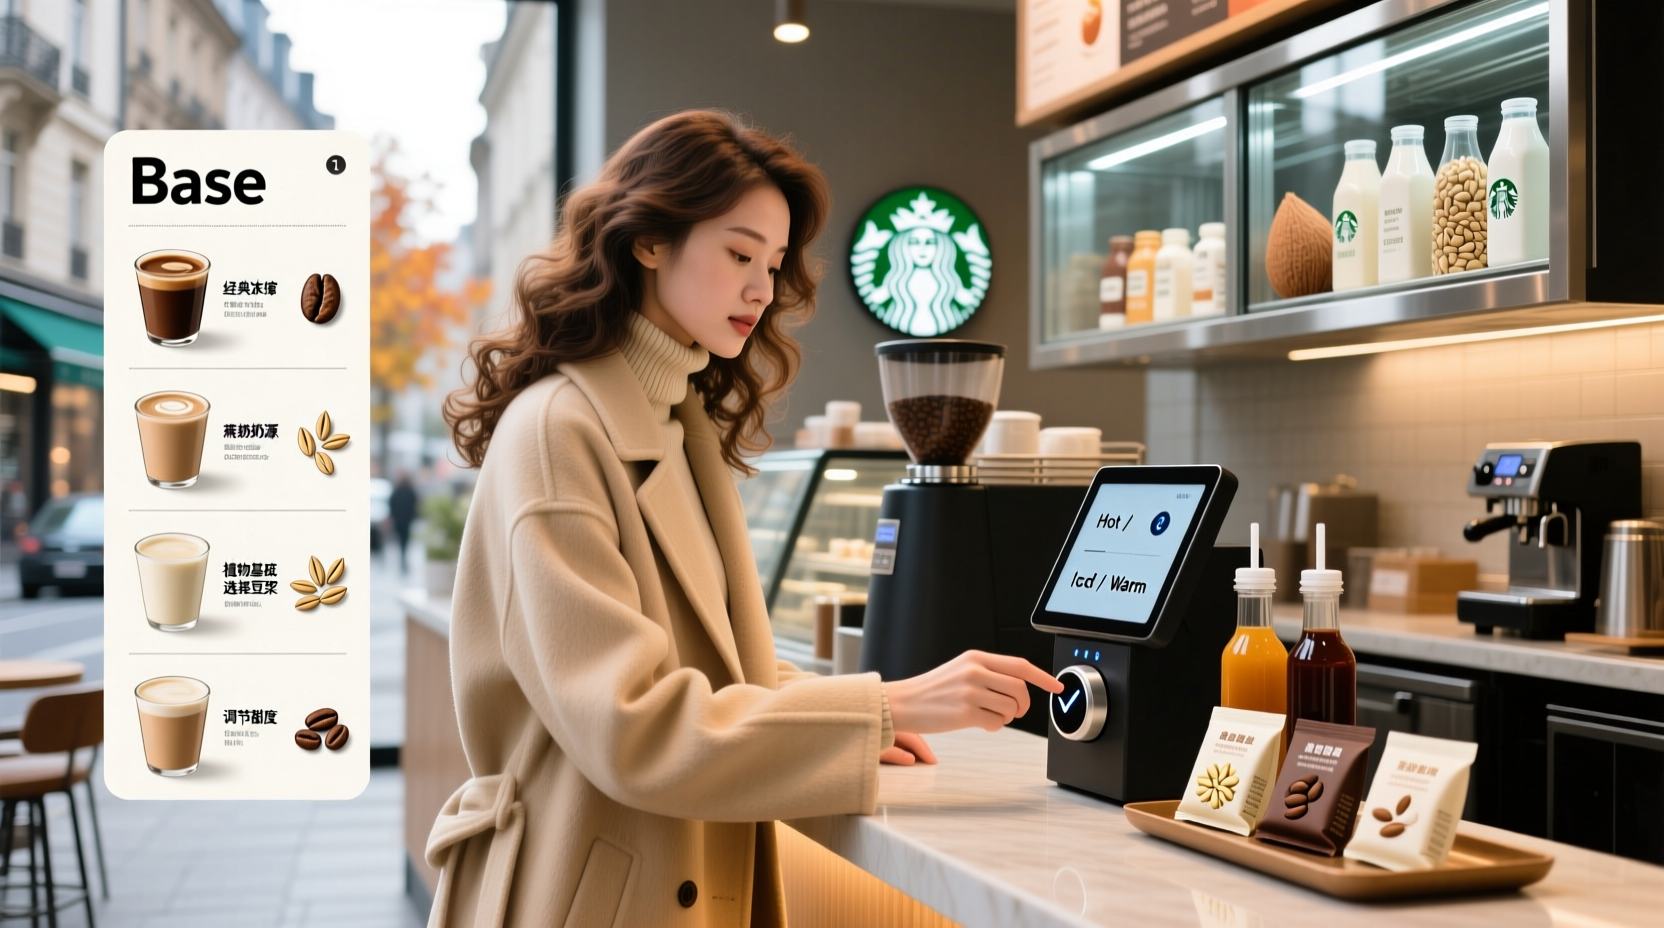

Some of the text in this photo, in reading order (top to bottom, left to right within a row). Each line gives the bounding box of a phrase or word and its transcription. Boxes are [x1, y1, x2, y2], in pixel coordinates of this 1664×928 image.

[1096, 513, 1134, 532] Hot /
[1095, 574, 1108, 592] /
[1110, 575, 1147, 594] Warm
